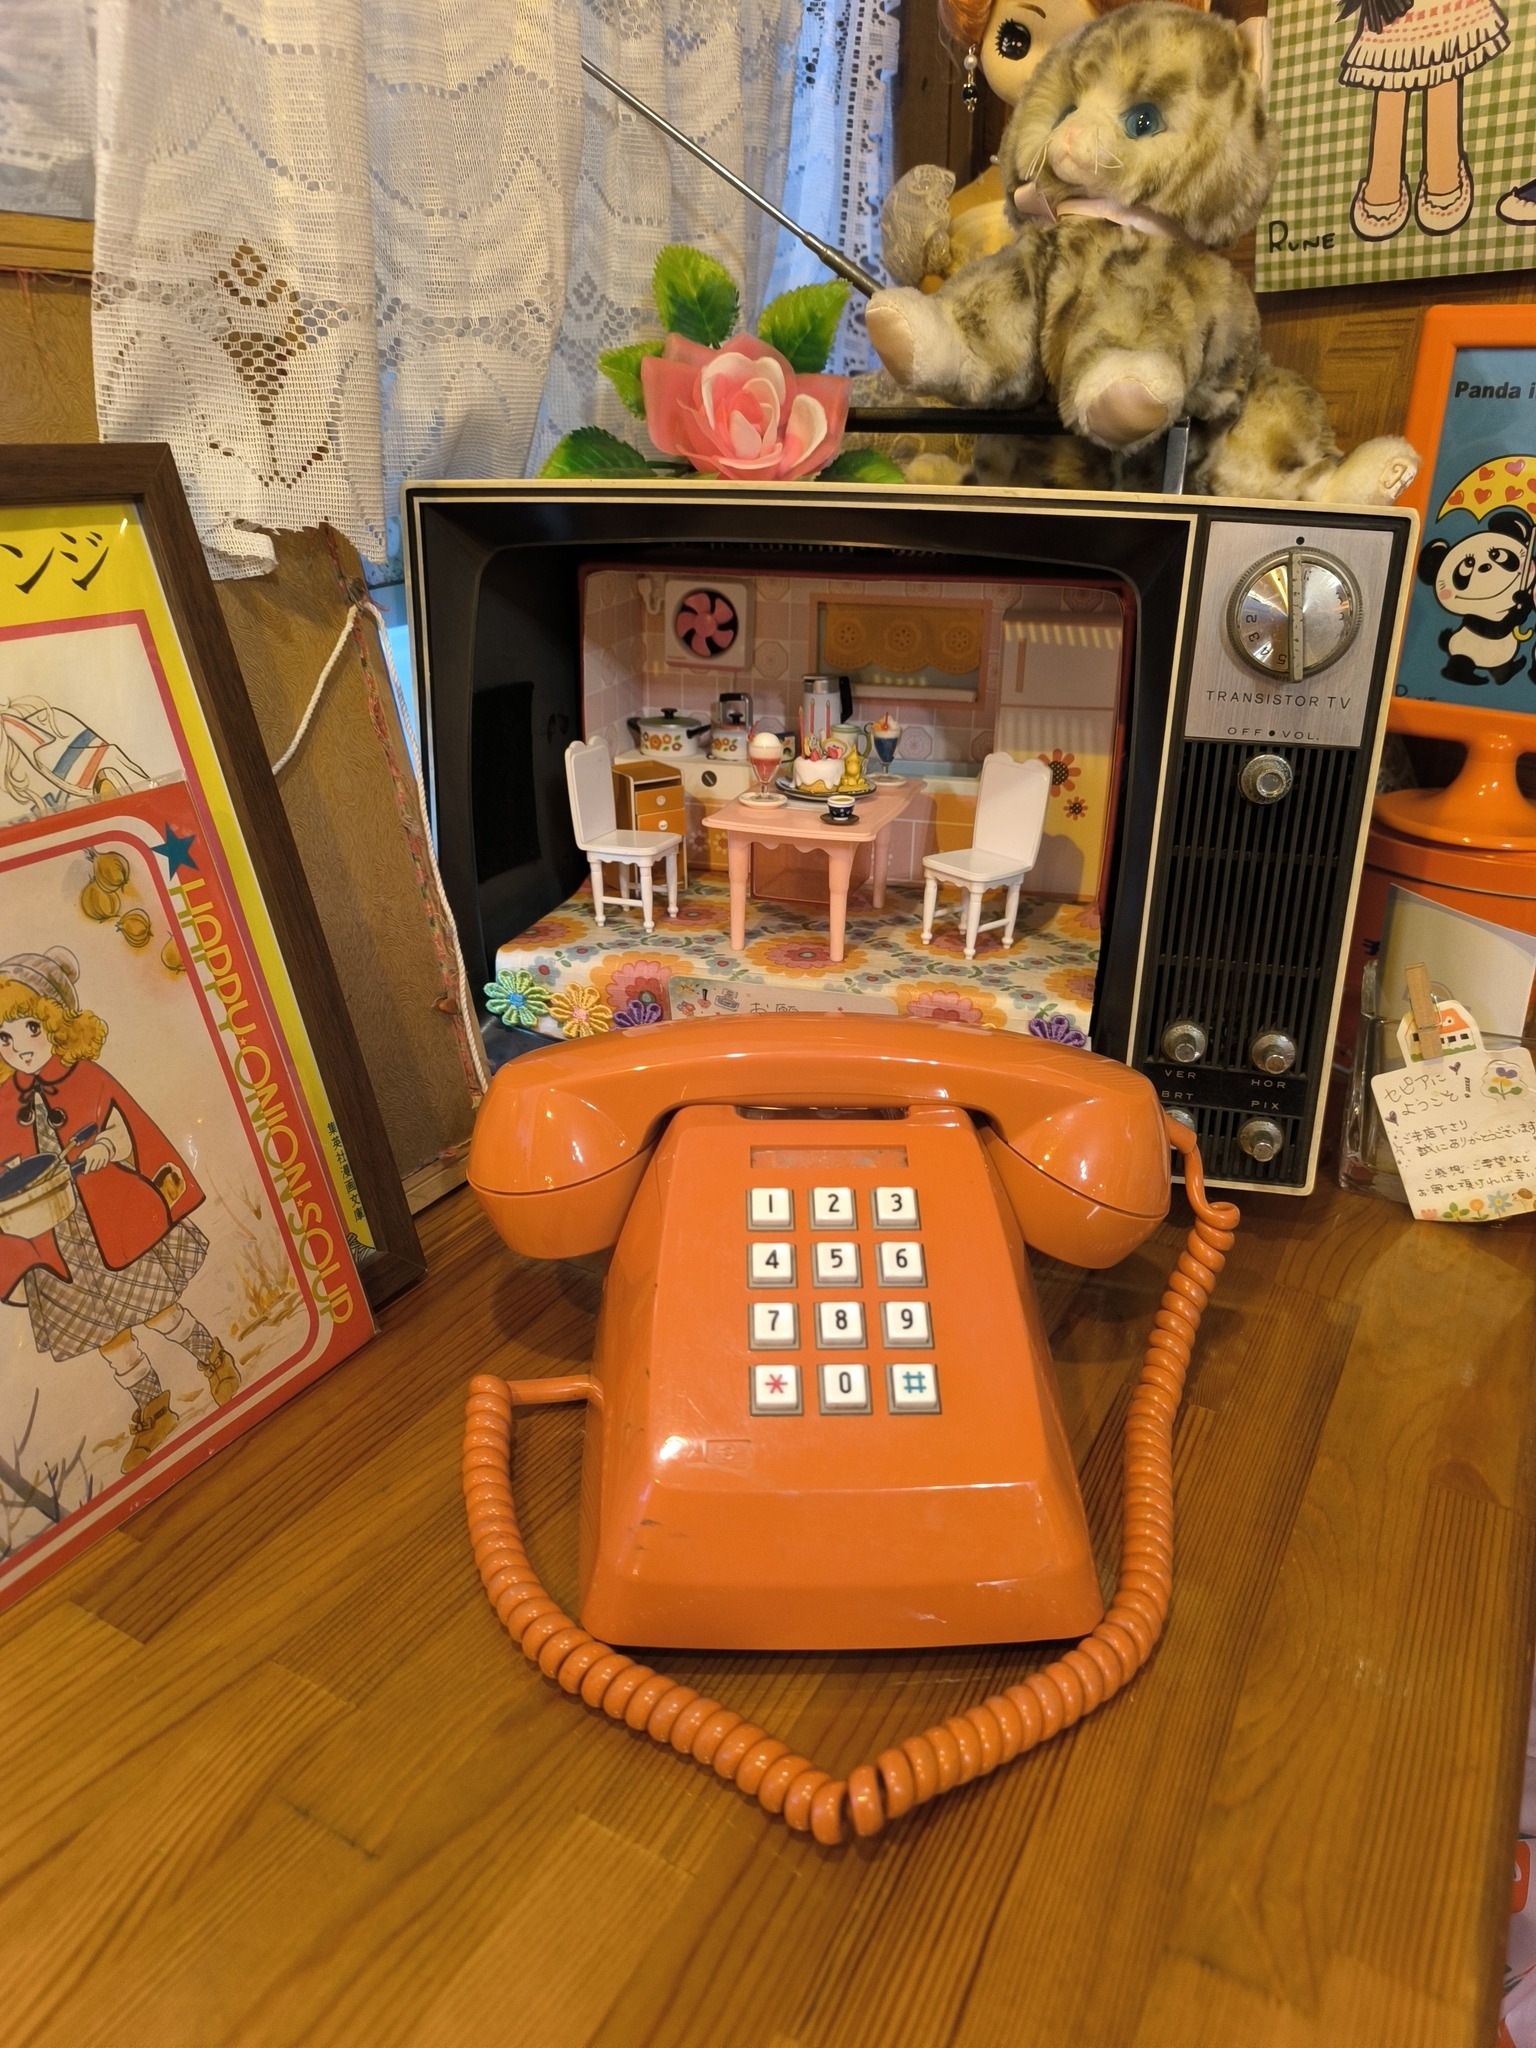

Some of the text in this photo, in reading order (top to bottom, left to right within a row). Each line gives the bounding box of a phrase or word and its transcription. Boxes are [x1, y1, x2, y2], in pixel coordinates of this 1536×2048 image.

[1269, 220, 1336, 253] RUNE
[1455, 381, 1522, 399] Panda
[1246, 614, 1257, 624] 2
[1248, 632, 1260, 642] 3
[1206, 690, 1351, 709] TRANSISTOR TV
[1227, 726, 1262, 737] OFF
[1164, 1069, 1286, 1089] VER HOR
[1384, 1074, 1446, 1103] セピアに
[169, 878, 354, 1324] HAPPY ONION SOUP
[1161, 1090, 1279, 1110] BRT PIX
[326, 1121, 365, 1222] 集英社漫画文庫
[828, 1193, 840, 1212] 2
[891, 1193, 903, 1212] 3
[765, 1248, 908, 1269] 4 5 6
[768, 1308, 913, 1331] 7 8 9
[839, 1371, 851, 1394] 0
